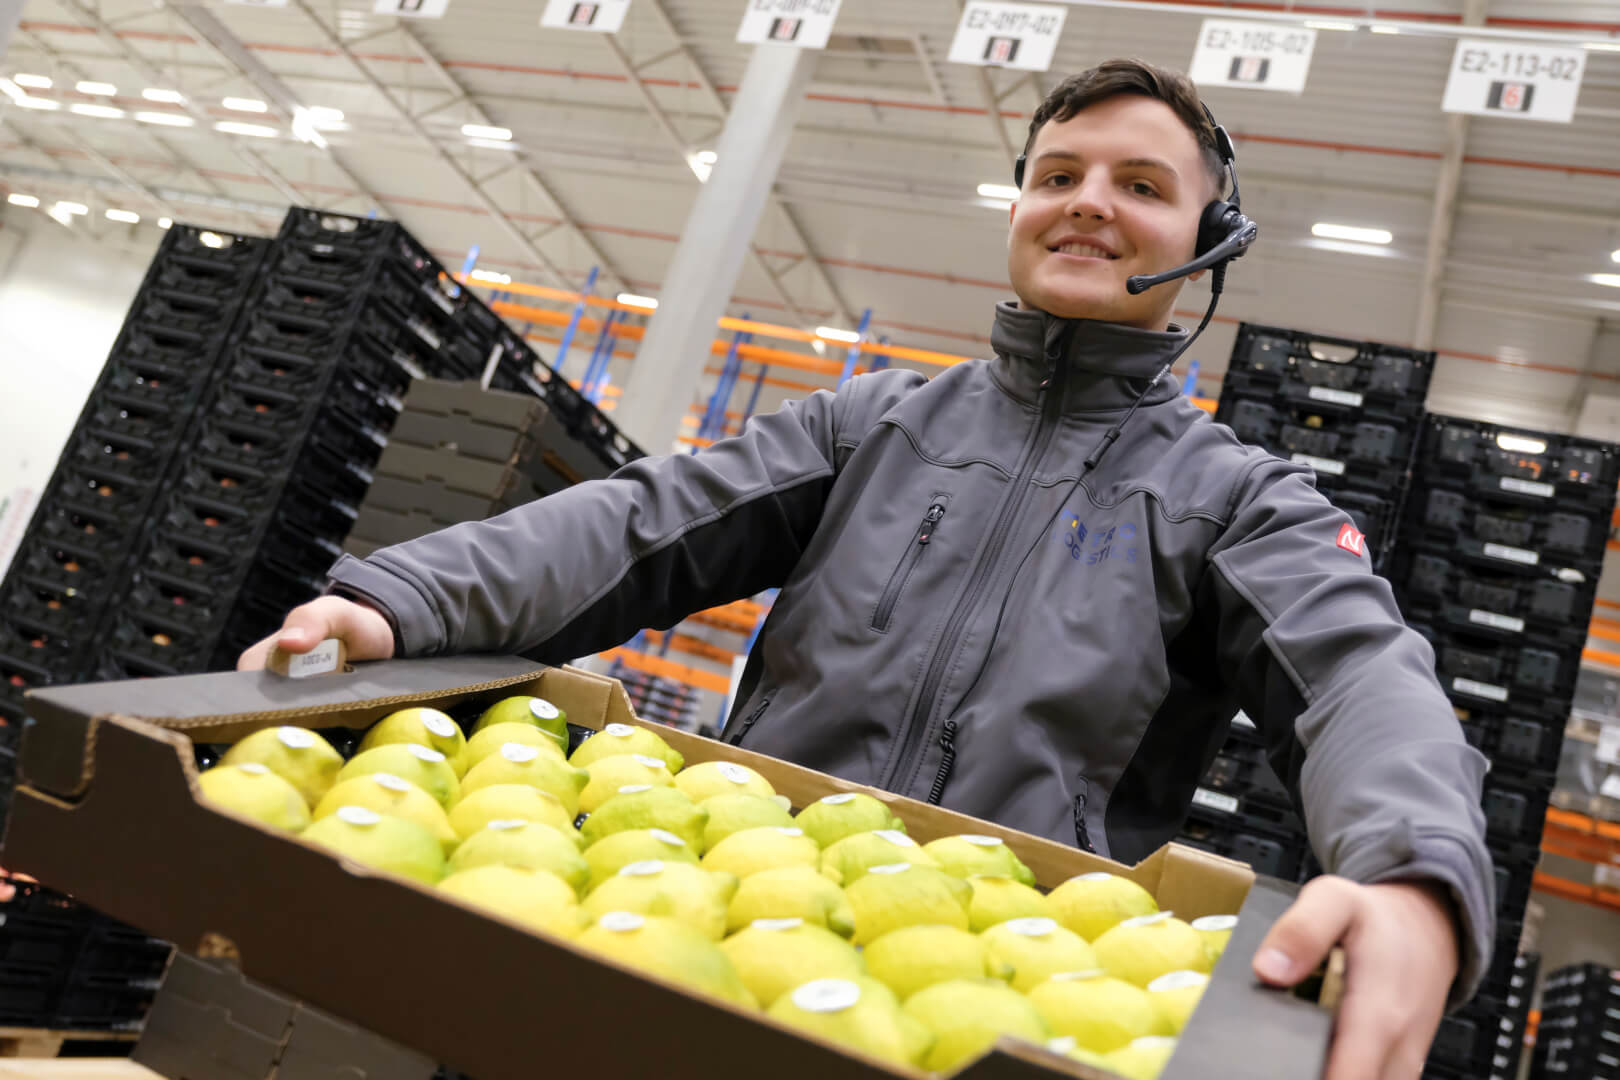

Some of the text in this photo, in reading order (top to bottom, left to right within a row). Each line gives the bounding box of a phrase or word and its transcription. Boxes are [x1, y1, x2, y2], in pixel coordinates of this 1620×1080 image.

[1206, 27, 1310, 54] E2-105-02
[1460, 49, 1578, 81] E2-113-02
[1503, 87, 1520, 107] 6
